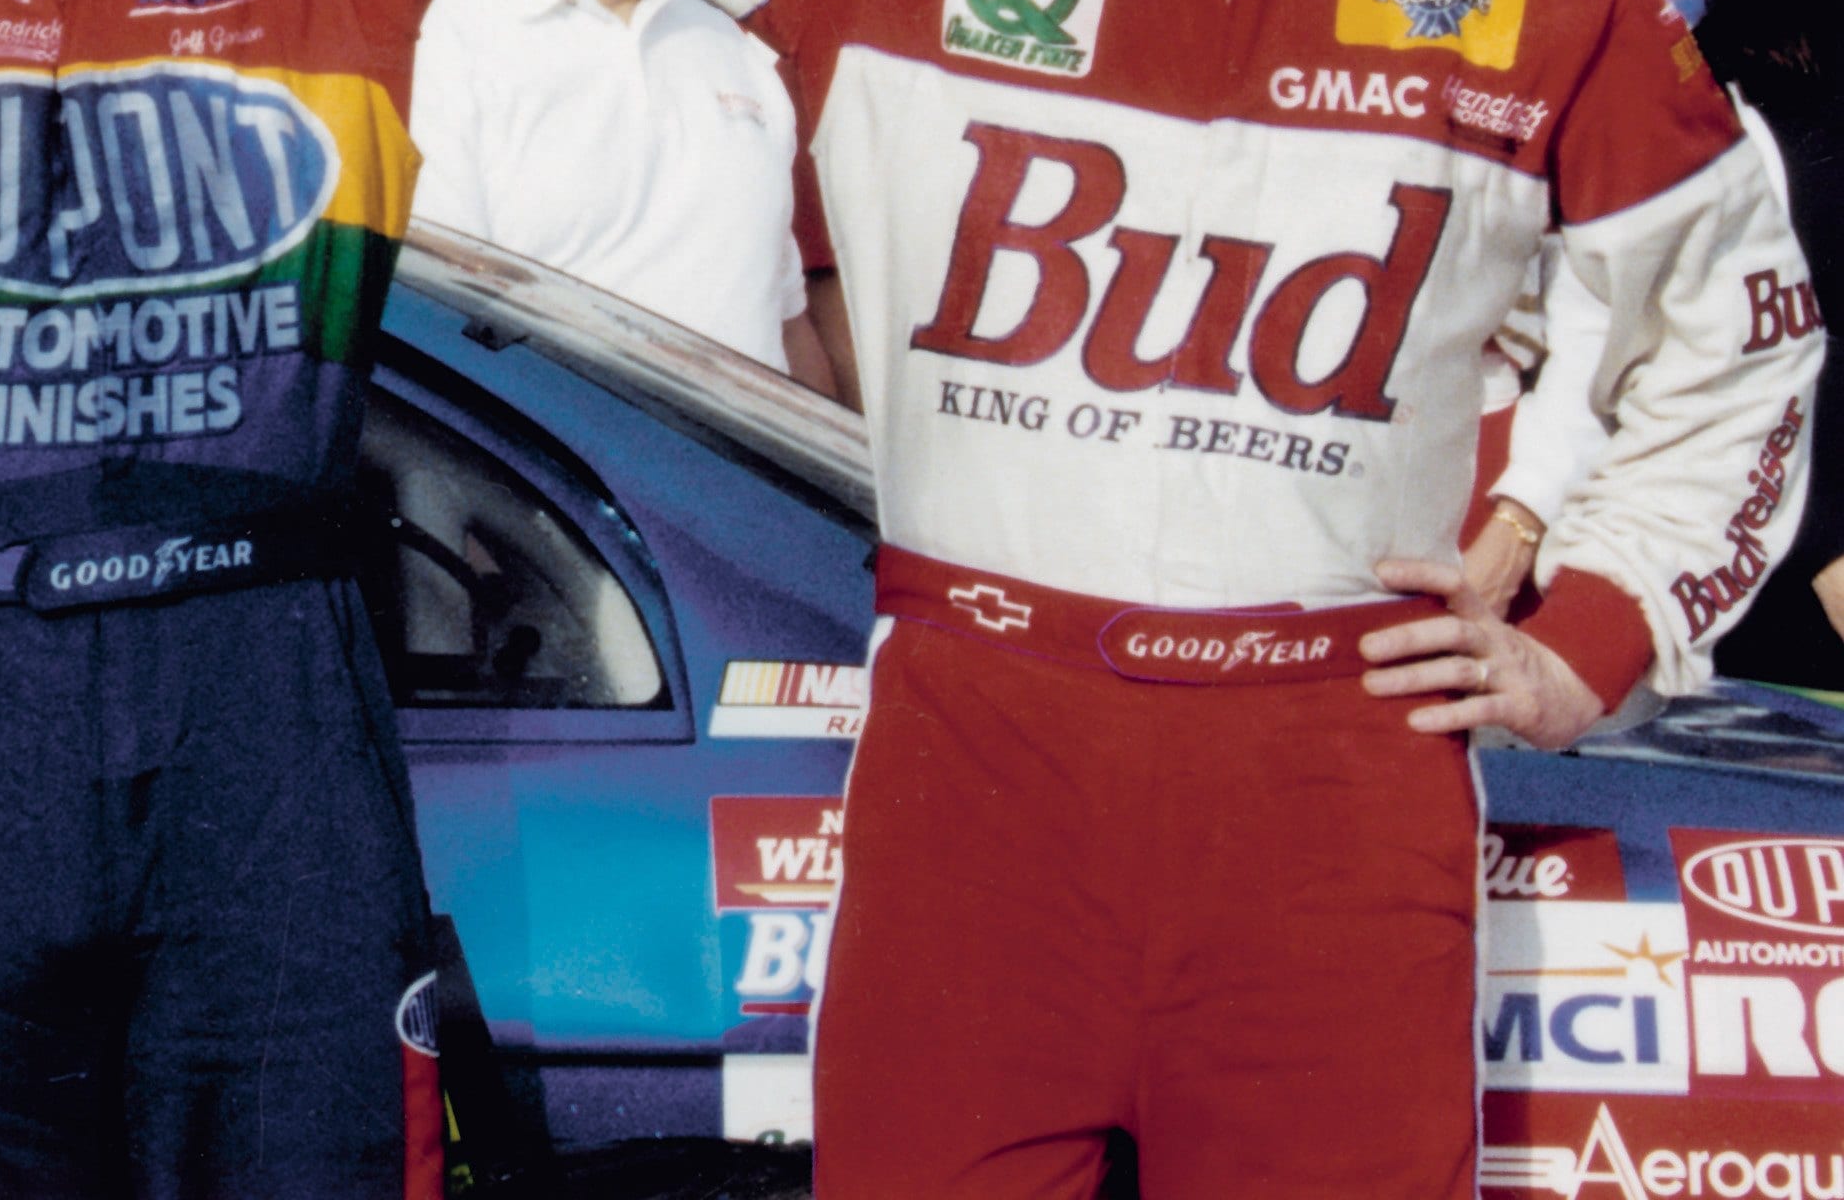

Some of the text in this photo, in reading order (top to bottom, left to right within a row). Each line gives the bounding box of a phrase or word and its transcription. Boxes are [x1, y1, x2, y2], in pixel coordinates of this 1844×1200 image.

[1269, 67, 1429, 118] GMAC
[908, 119, 1455, 425] Bud
[937, 380, 1353, 478] KING OF BEERS
